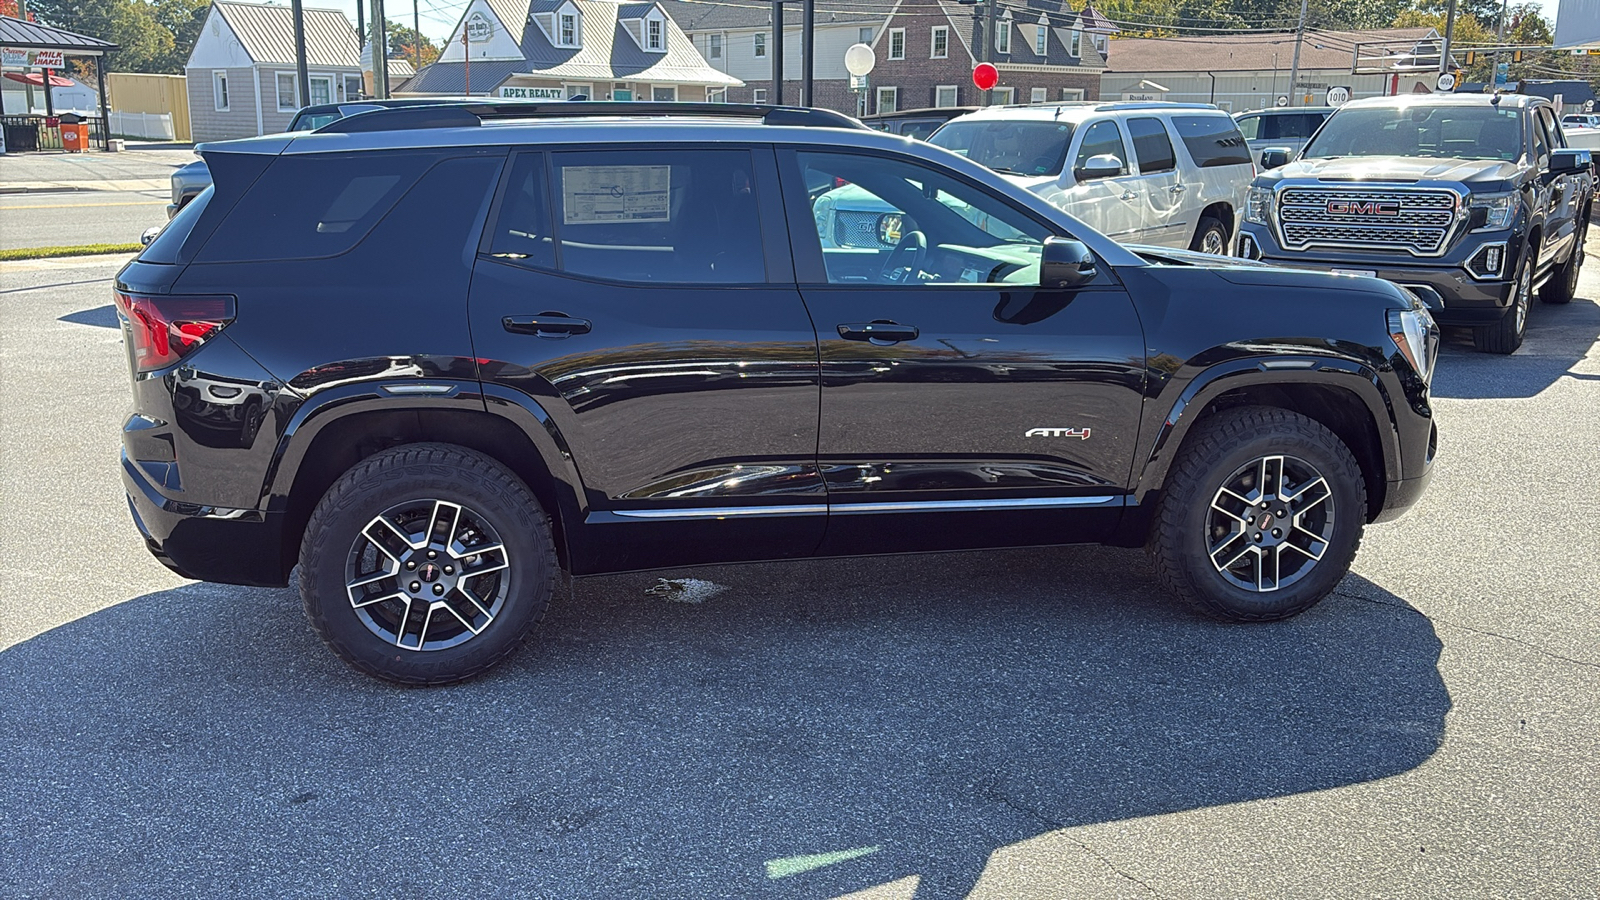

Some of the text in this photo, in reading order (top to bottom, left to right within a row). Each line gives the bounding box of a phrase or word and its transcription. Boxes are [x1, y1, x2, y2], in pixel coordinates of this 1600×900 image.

[39, 51, 63, 59] MILK
[34, 57, 63, 66] SHAKES
[503, 88, 562, 99] APEX REALTY
[1327, 201, 1399, 216] GMC
[1025, 427, 1091, 441] AT4
